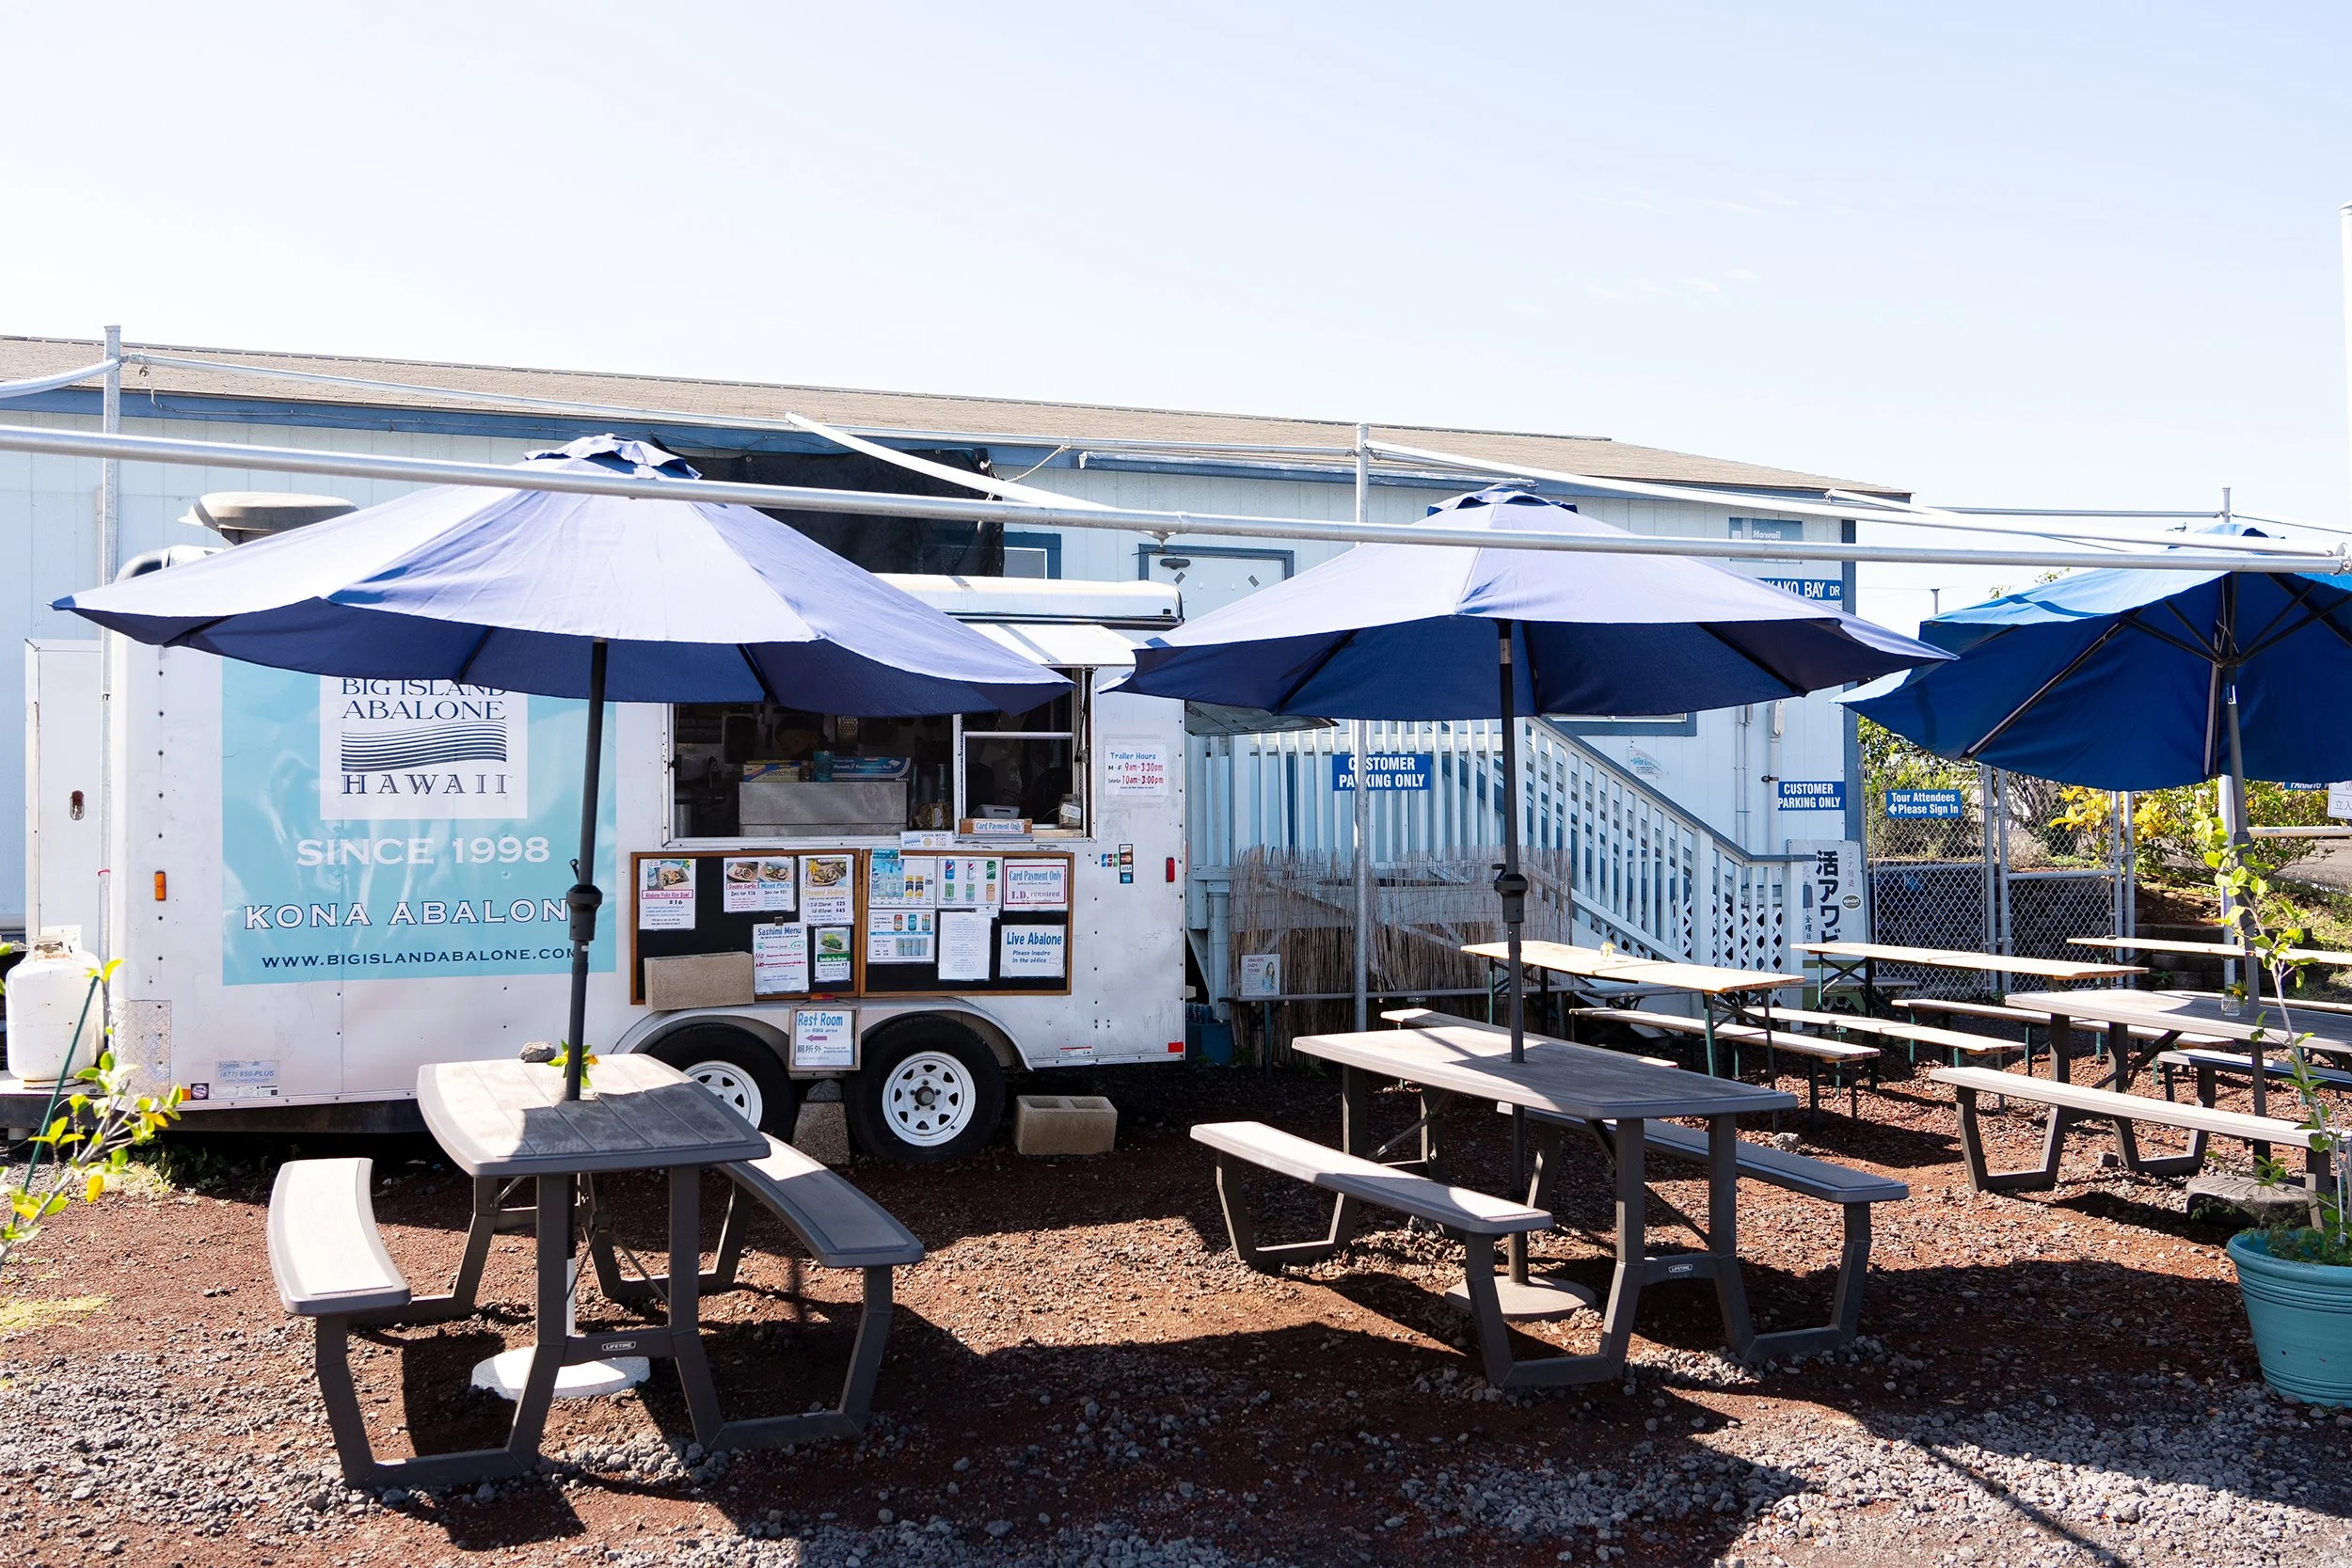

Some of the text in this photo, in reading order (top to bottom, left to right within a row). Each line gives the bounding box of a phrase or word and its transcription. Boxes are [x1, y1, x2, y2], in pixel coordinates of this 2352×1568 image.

[1753, 530, 1781, 539] Hawaii
[1804, 582, 1825, 598] BAY
[1830, 586, 1840, 596] DR
[342, 678, 390, 695] BIG
[342, 700, 506, 721] ABALONE
[1349, 757, 1415, 770] CSTOMER
[342, 774, 507, 794] HAWAII
[1339, 774, 1424, 787] PAKING ONLY
[1784, 784, 1833, 795] CUSTOMER
[1778, 797, 1840, 808] PARKING ONLY
[1892, 793, 1955, 802] Tour Attendees
[1898, 805, 1958, 816] Please Sign In
[989, 822, 1009, 831] Payment
[1010, 822, 1021, 831] Only
[297, 836, 550, 866] SINCE 1998
[1009, 870, 1061, 883] Card Payment Only
[1012, 891, 1029, 899] I.D.
[1816, 850, 1841, 943] 活アワビ
[245, 897, 567, 929] KONA ABALON
[758, 927, 782, 935] Sashimi
[1007, 932, 1062, 945] Live Abalone
[798, 1012, 843, 1026] Rest Room
